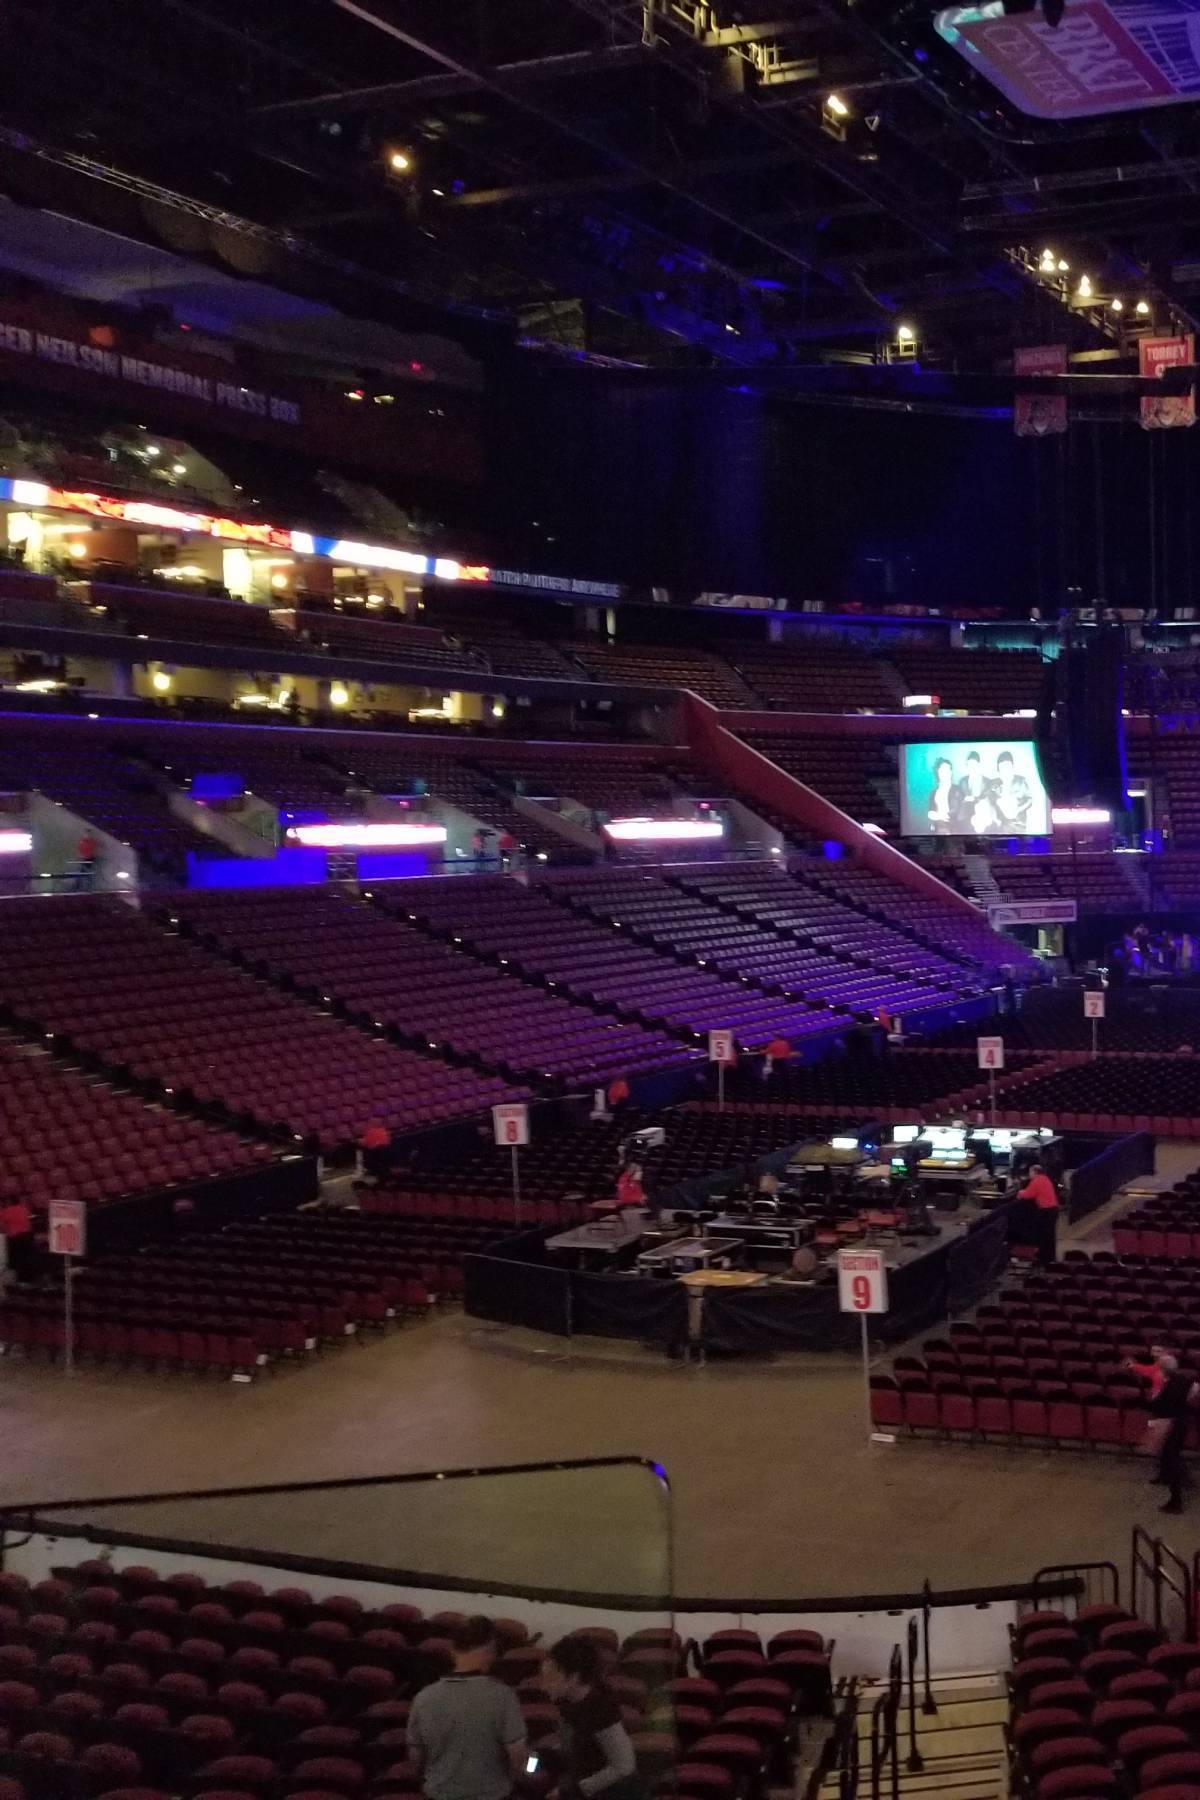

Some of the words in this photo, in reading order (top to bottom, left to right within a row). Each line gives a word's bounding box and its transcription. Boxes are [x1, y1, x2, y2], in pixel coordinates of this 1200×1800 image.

[1146, 344, 1187, 361] TORREY
[121, 354, 214, 402] MEMORIAL
[216, 382, 267, 416] PRESS
[1089, 1001, 1098, 1015] 2
[716, 1041, 725, 1057] 5
[986, 1049, 995, 1066] 4
[852, 1275, 871, 1309] 9
